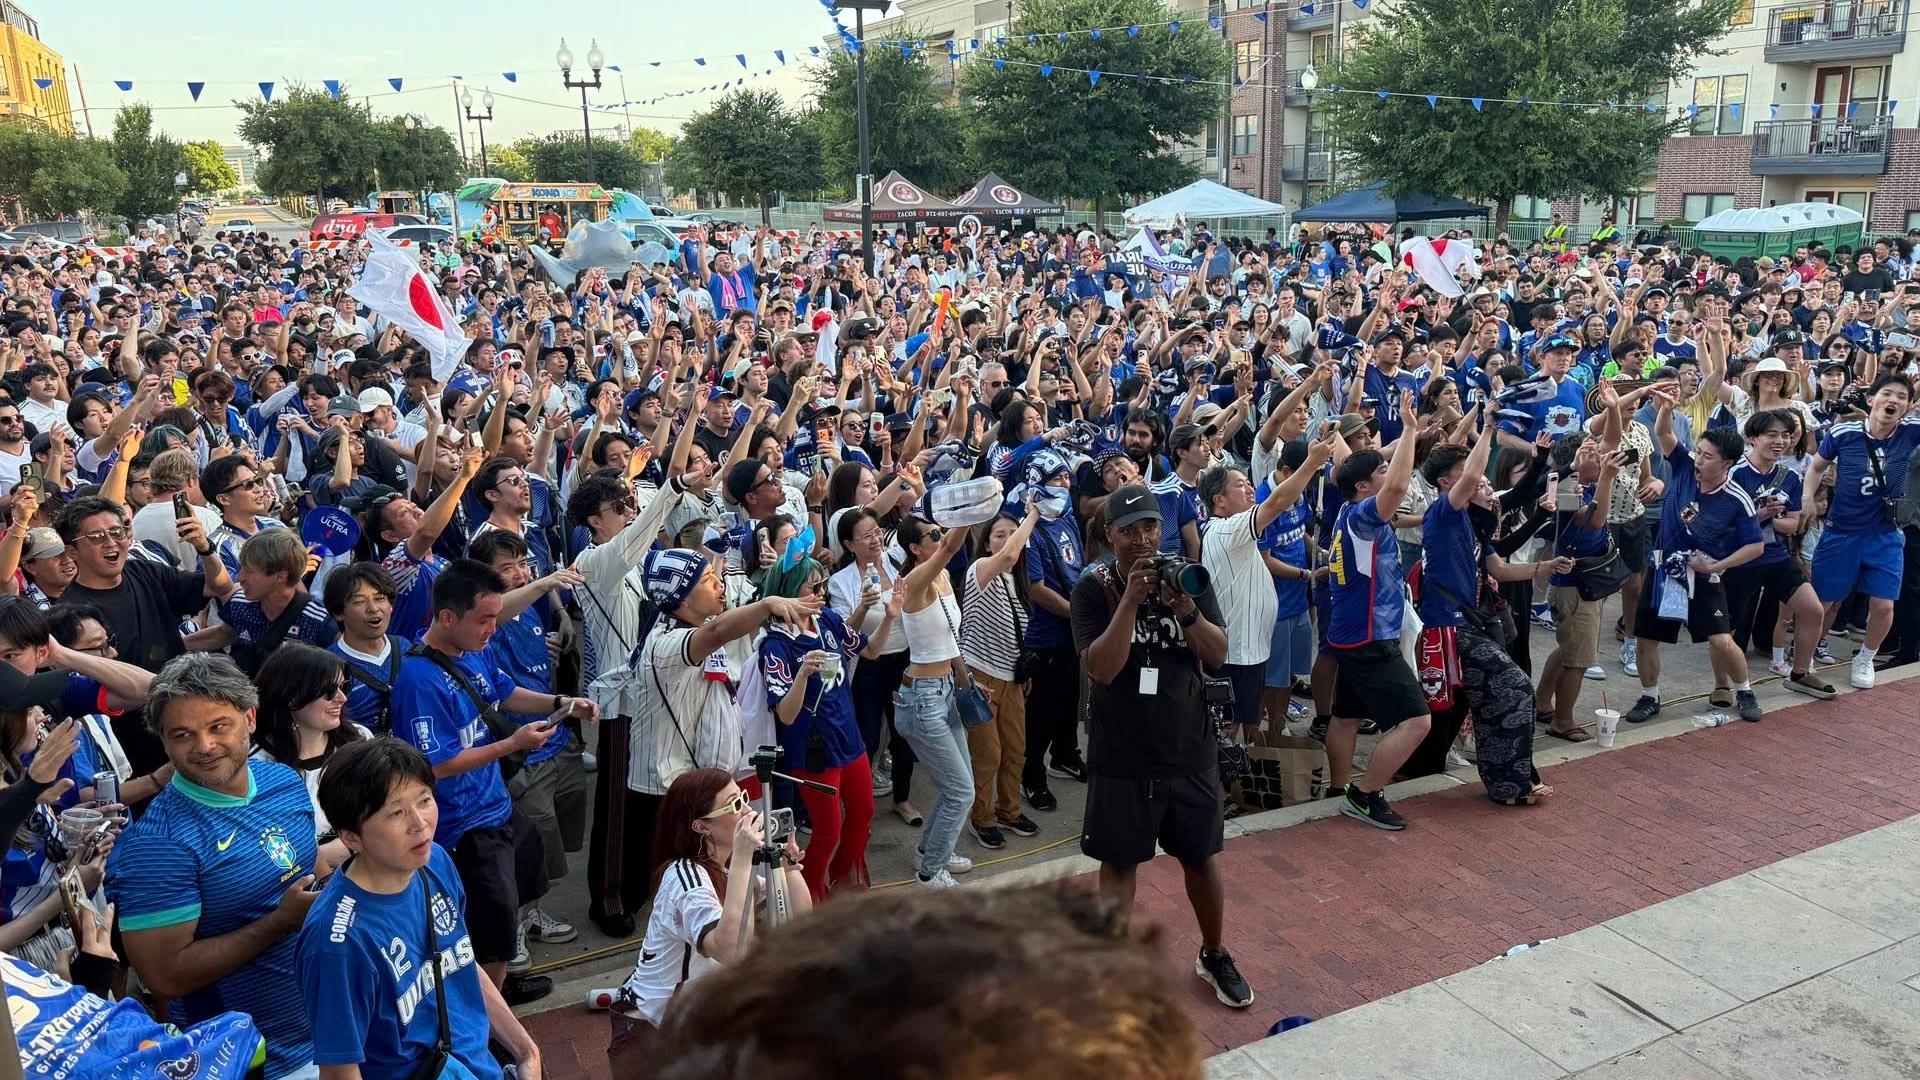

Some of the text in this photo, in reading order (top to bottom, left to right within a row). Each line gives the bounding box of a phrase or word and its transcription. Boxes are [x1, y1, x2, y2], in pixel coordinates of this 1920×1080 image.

[531, 187, 561, 198] KONA
[897, 210, 917, 218] TACOS
[322, 218, 357, 234] dna
[320, 515, 348, 536] ULTRA
[215, 1036, 236, 1068] LIFE
[53, 1053, 79, 1080] 6/25
